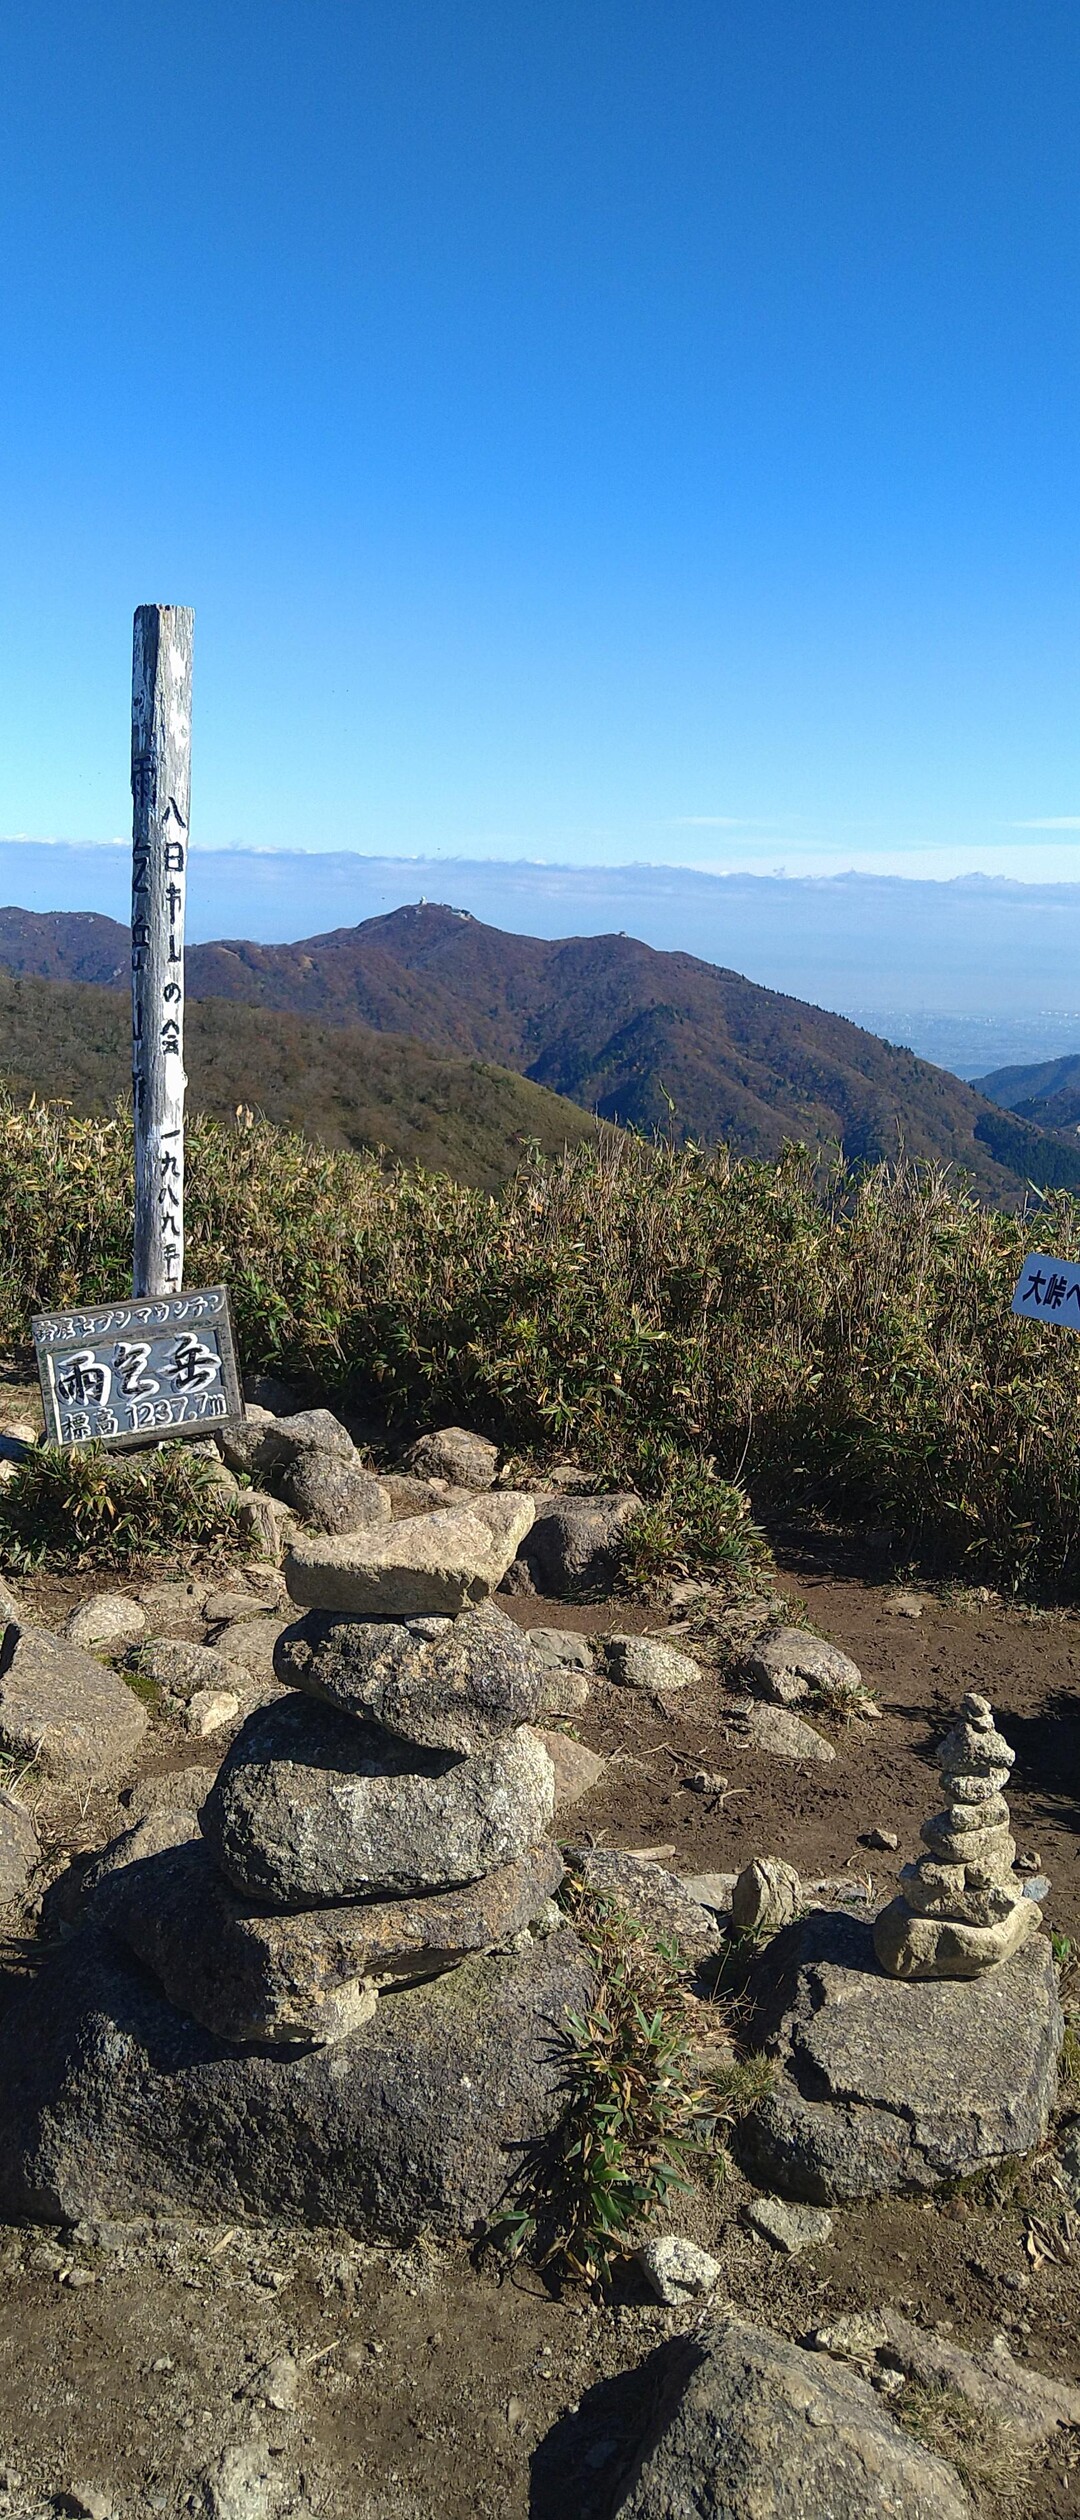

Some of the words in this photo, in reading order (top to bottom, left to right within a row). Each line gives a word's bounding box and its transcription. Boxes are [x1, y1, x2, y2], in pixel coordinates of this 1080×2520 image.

[56, 1331, 222, 1408] 雨乞岳
[61, 1407, 119, 1441] 標高
